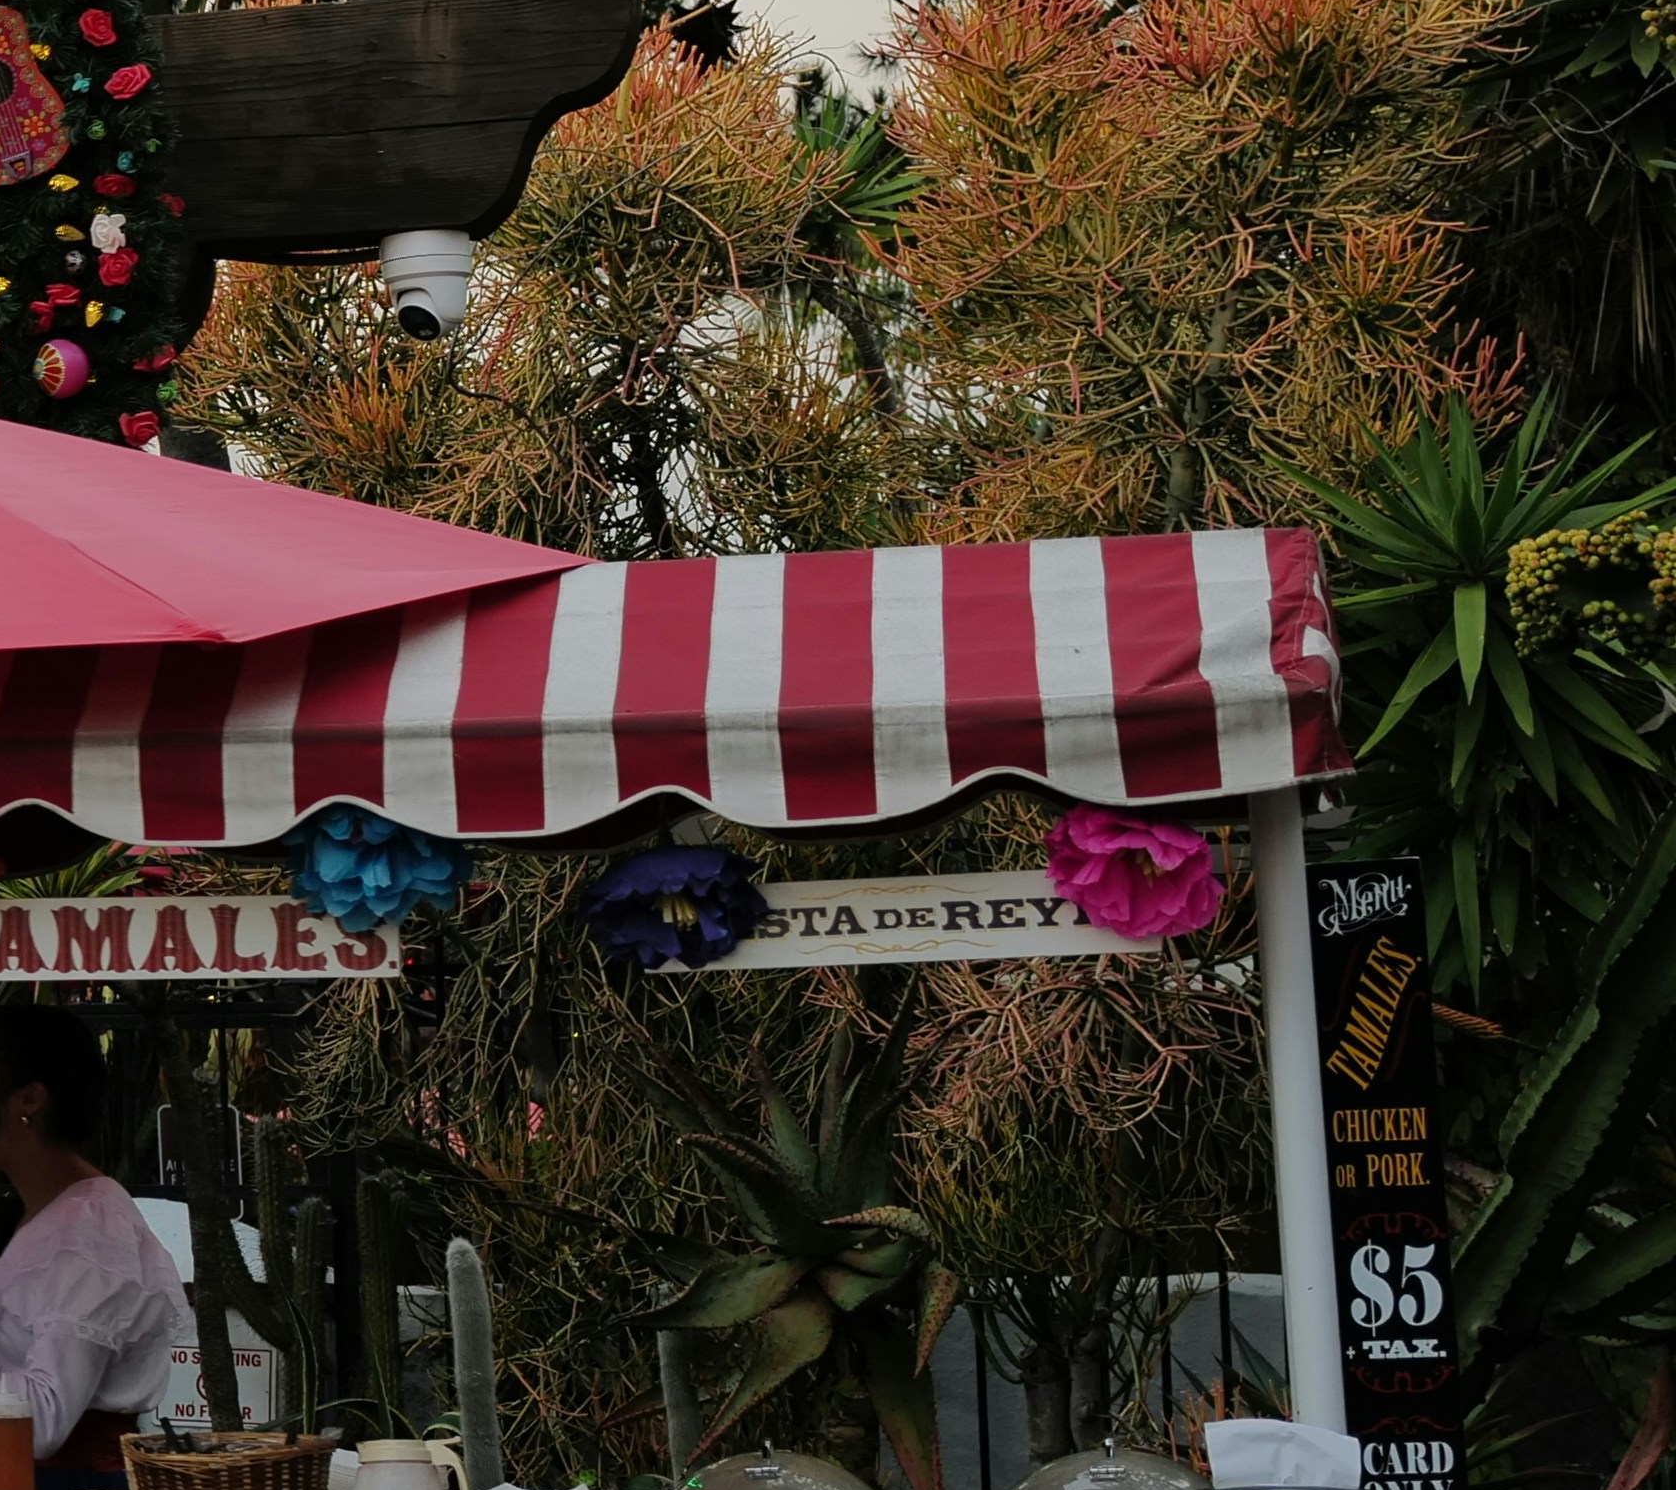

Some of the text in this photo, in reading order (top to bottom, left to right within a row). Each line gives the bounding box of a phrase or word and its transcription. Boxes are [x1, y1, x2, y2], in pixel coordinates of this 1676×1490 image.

[873, 907, 938, 930] DE
[940, 896, 1091, 931] REY
[1325, 935, 1424, 1092] TAMALES.
[1332, 1106, 1428, 1144] CHICKEN
[1335, 1152, 1432, 1188] OR PORK.
[1349, 1238, 1445, 1338] $5
[191, 1351, 262, 1368] SING
[1361, 1338, 1448, 1360] TAX.
[175, 1404, 196, 1418] NO
[1362, 1440, 1455, 1476] CARD
